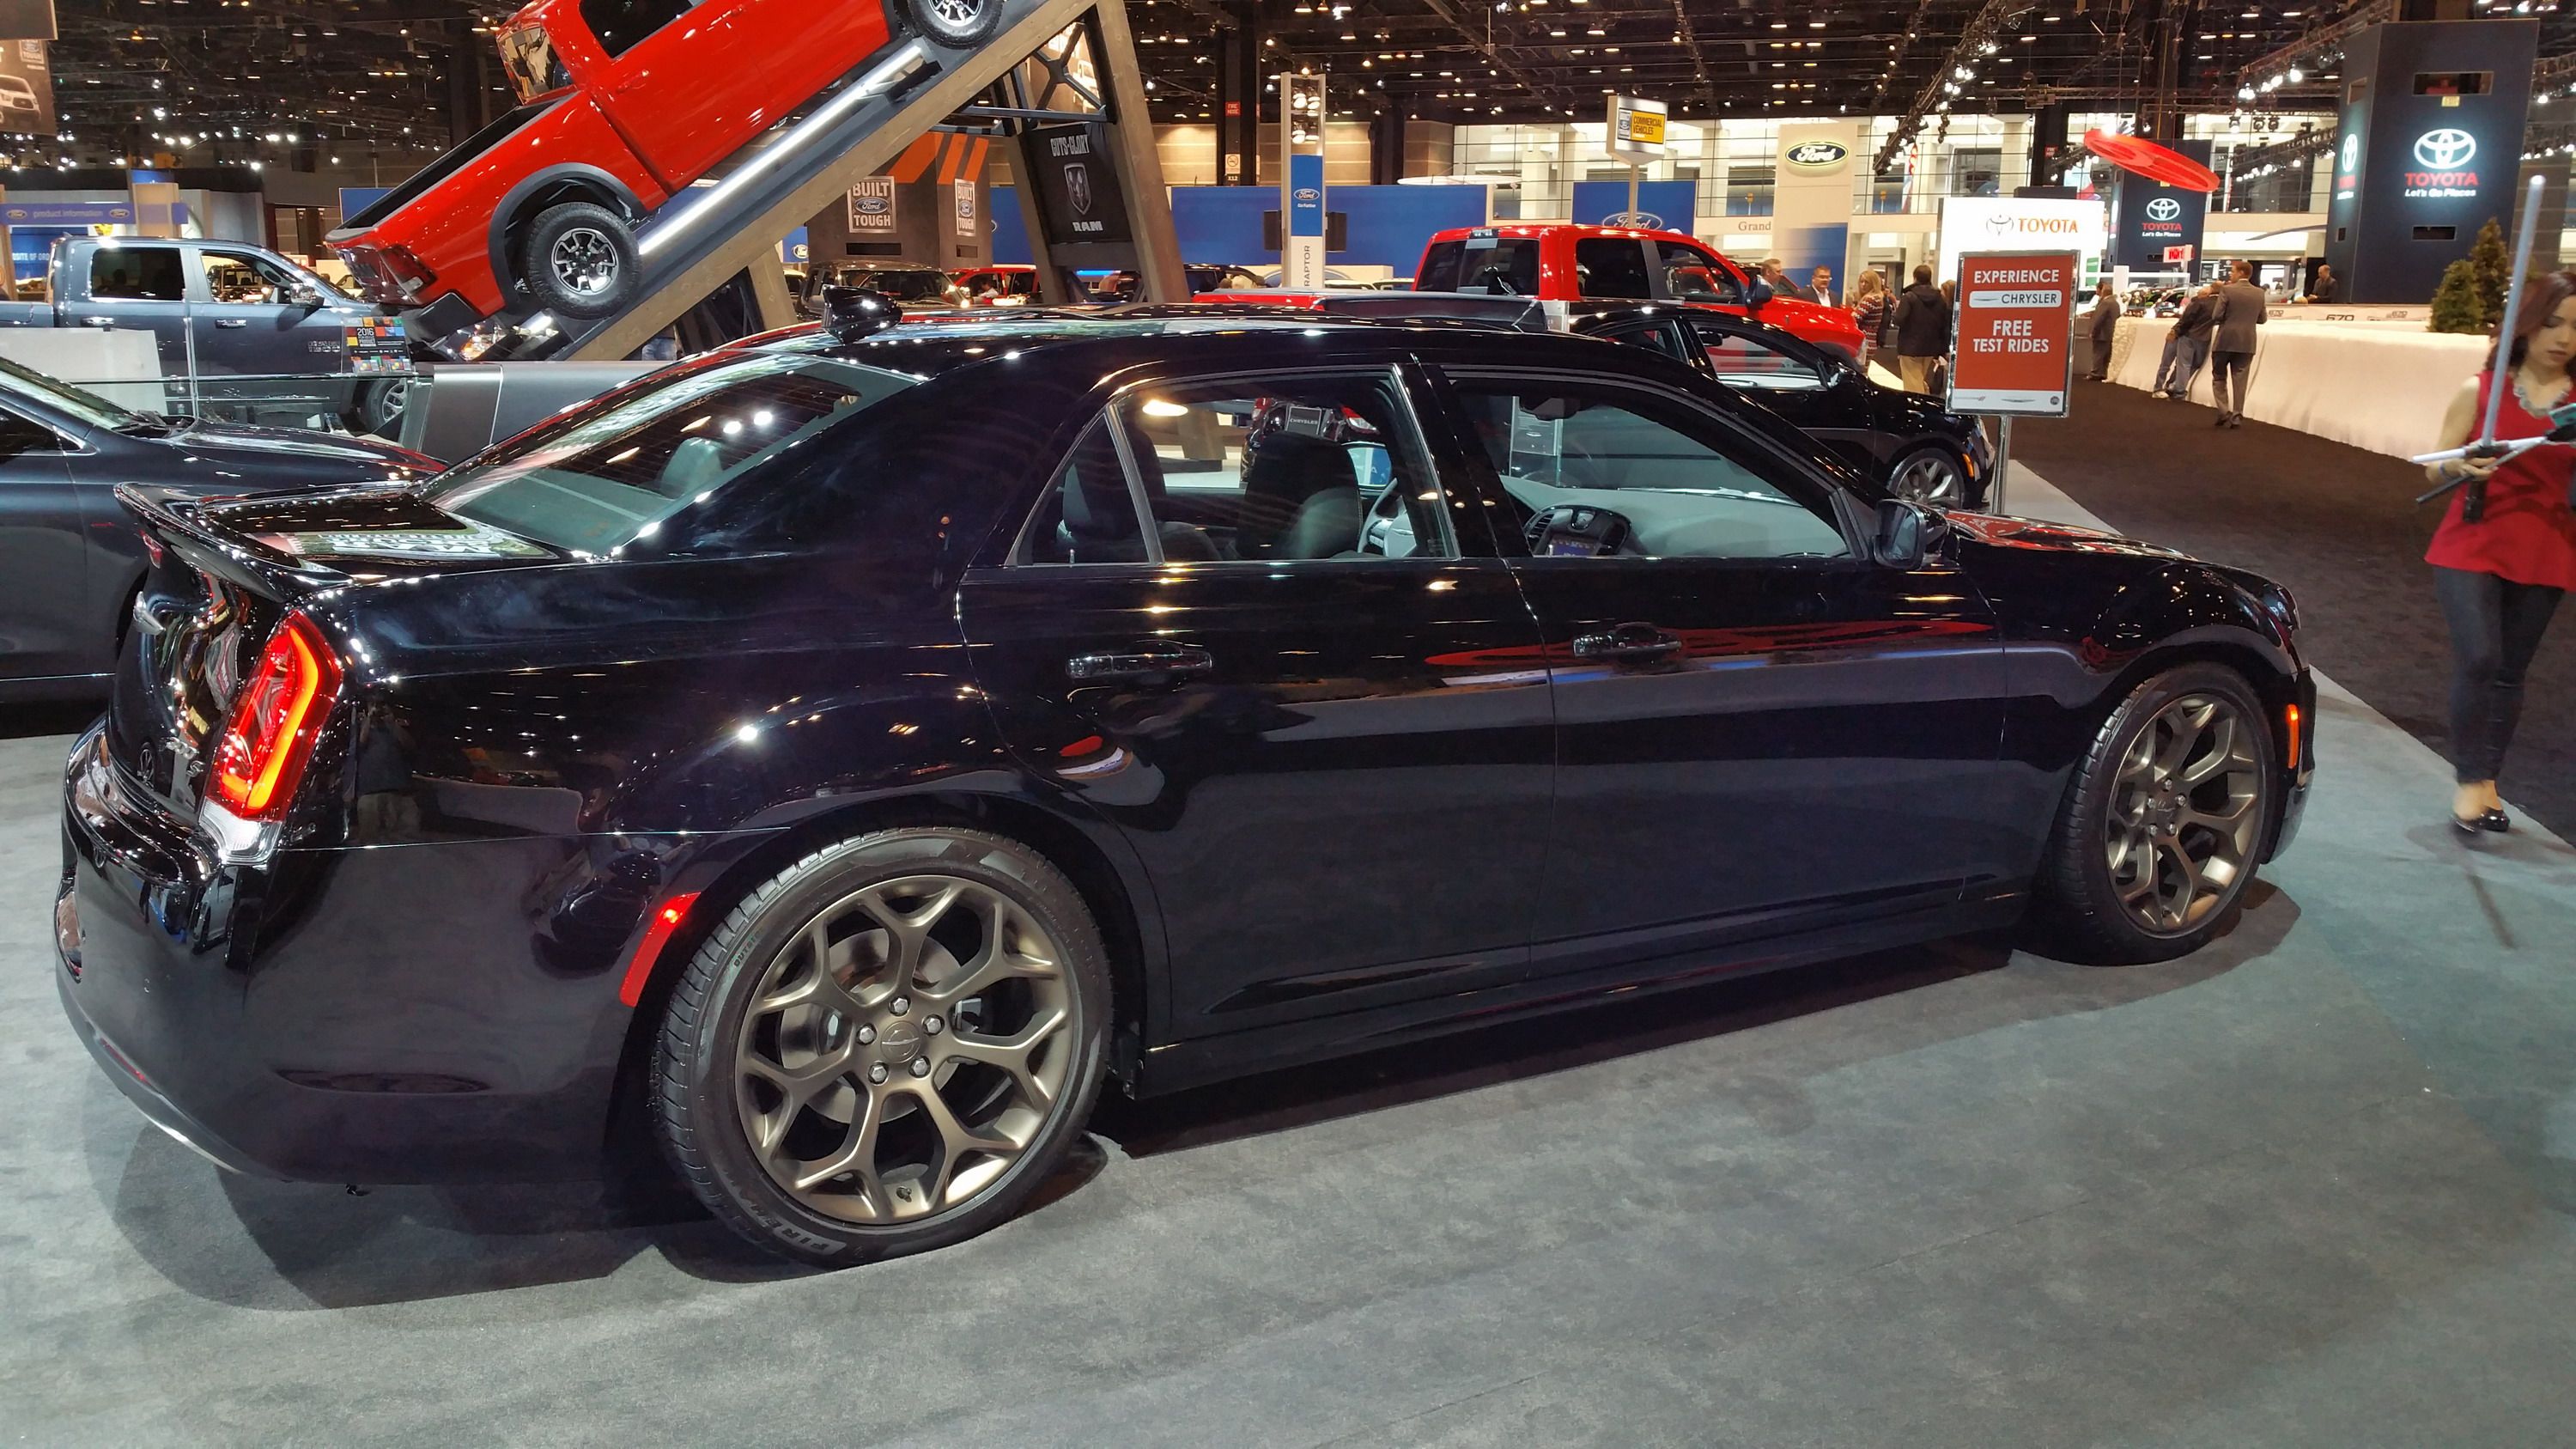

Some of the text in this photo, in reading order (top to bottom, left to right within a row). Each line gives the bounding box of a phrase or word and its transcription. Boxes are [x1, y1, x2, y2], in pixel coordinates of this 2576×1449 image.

[1634, 116, 1662, 127] COMMERCIAL
[1633, 125, 1653, 135] VEHICLES
[1796, 145, 1837, 161] Ford
[2405, 173, 2479, 186] TOYOTA
[853, 182, 889, 196] BUILT
[862, 199, 882, 210] Ford
[854, 215, 891, 227] TOUGH
[1072, 221, 1103, 232] RAM
[1738, 221, 1771, 231] Grand
[2019, 218, 2079, 233] TOYOTA
[2142, 222, 2182, 231] TOYOTA
[1974, 270, 2059, 283] EXPERIENCE
[2002, 294, 2057, 304] CHRYSLER
[357, 327, 374, 337] 2016
[1993, 320, 2032, 336] FREE
[1973, 338, 2049, 353] TEST RIDES
